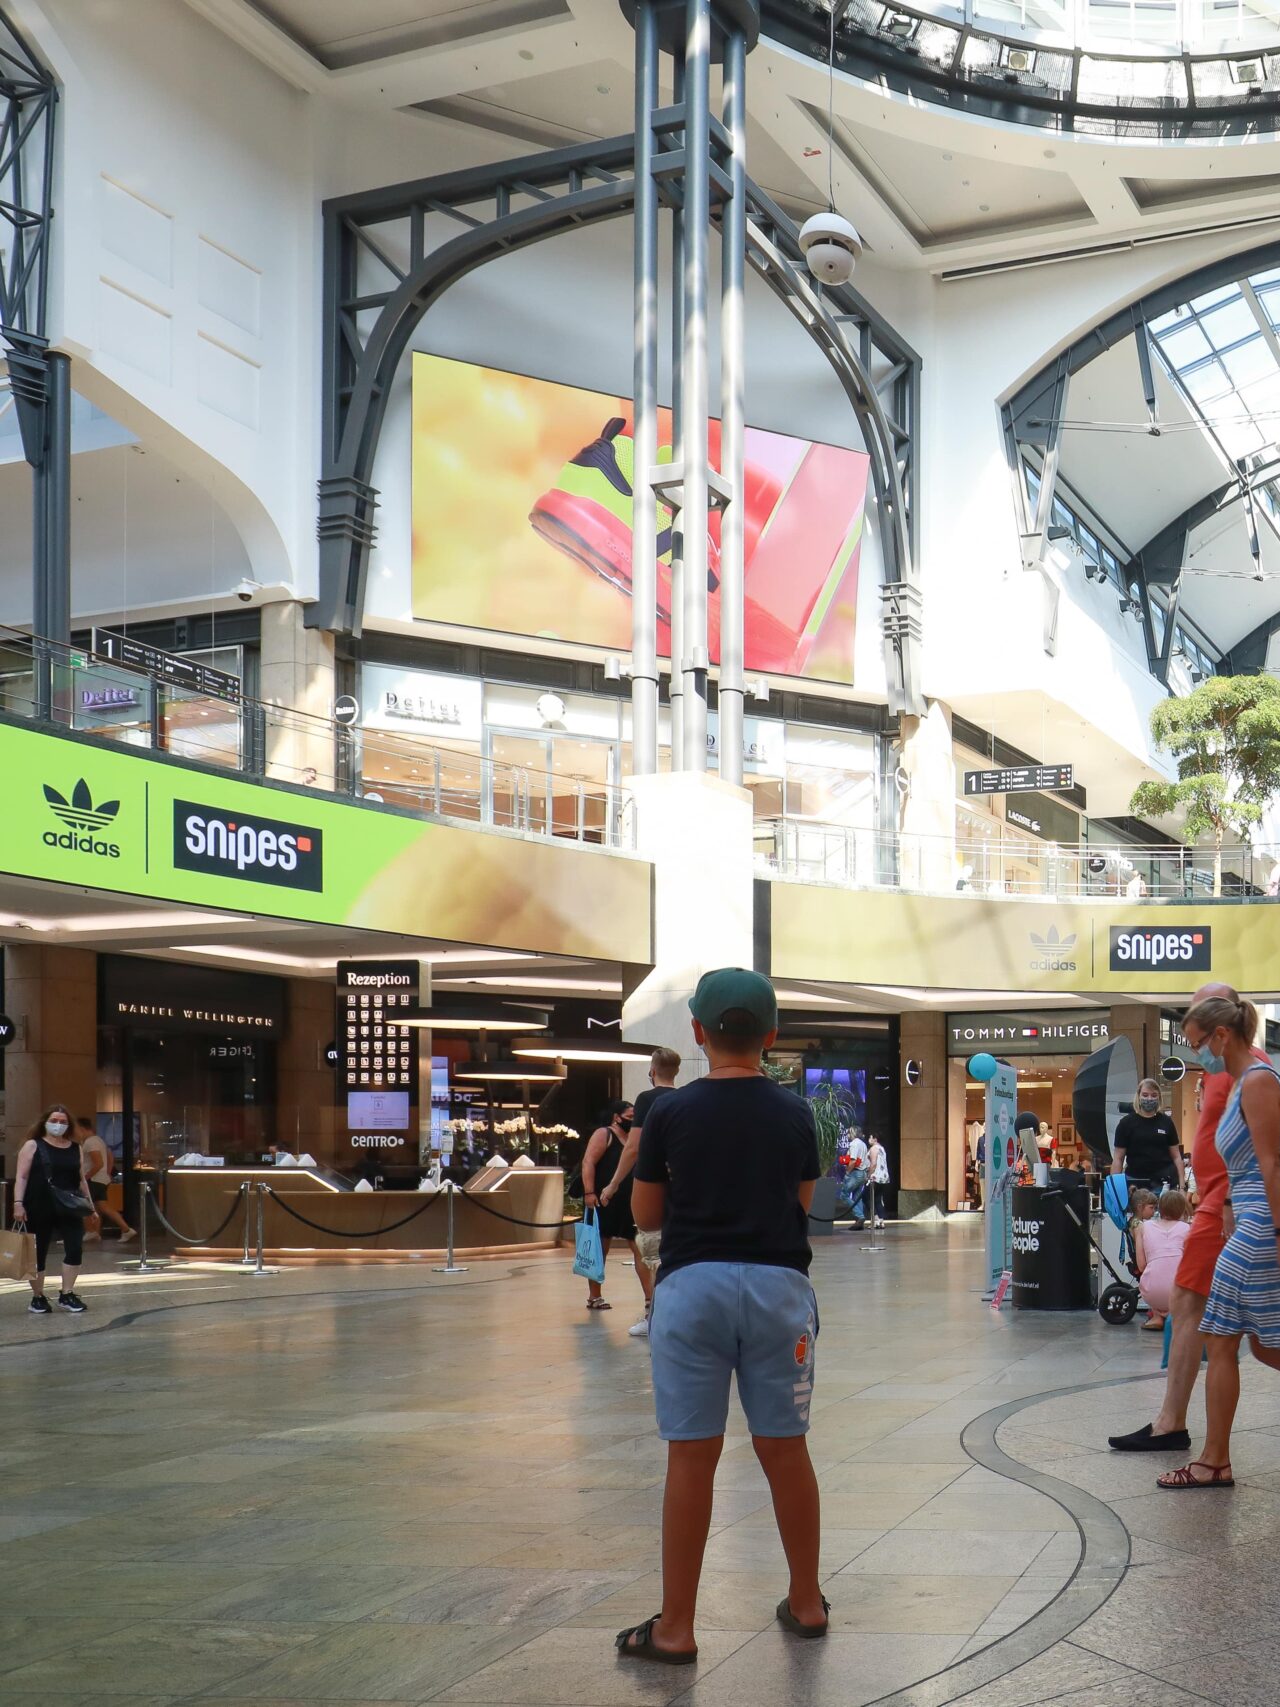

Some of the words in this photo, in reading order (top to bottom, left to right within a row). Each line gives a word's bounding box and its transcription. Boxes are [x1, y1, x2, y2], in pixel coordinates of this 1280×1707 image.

[102, 639, 113, 659] 1
[968, 775, 976, 791] 1
[1008, 810, 1031, 827] LACOSTE
[43, 831, 121, 858] adidas
[186, 815, 297, 871] snipes
[1117, 933, 1193, 965] snipes
[1029, 959, 1077, 971] adidas
[346, 972, 410, 988] Rezeption
[118, 1003, 174, 1017] DANIEL
[183, 1009, 273, 1027] WELLINGTON
[952, 1027, 1017, 1040] TOMMY
[1042, 1025, 1109, 1037] HILFIGER
[1011, 1217, 1040, 1235] icture
[1011, 1233, 1040, 1255] eople
